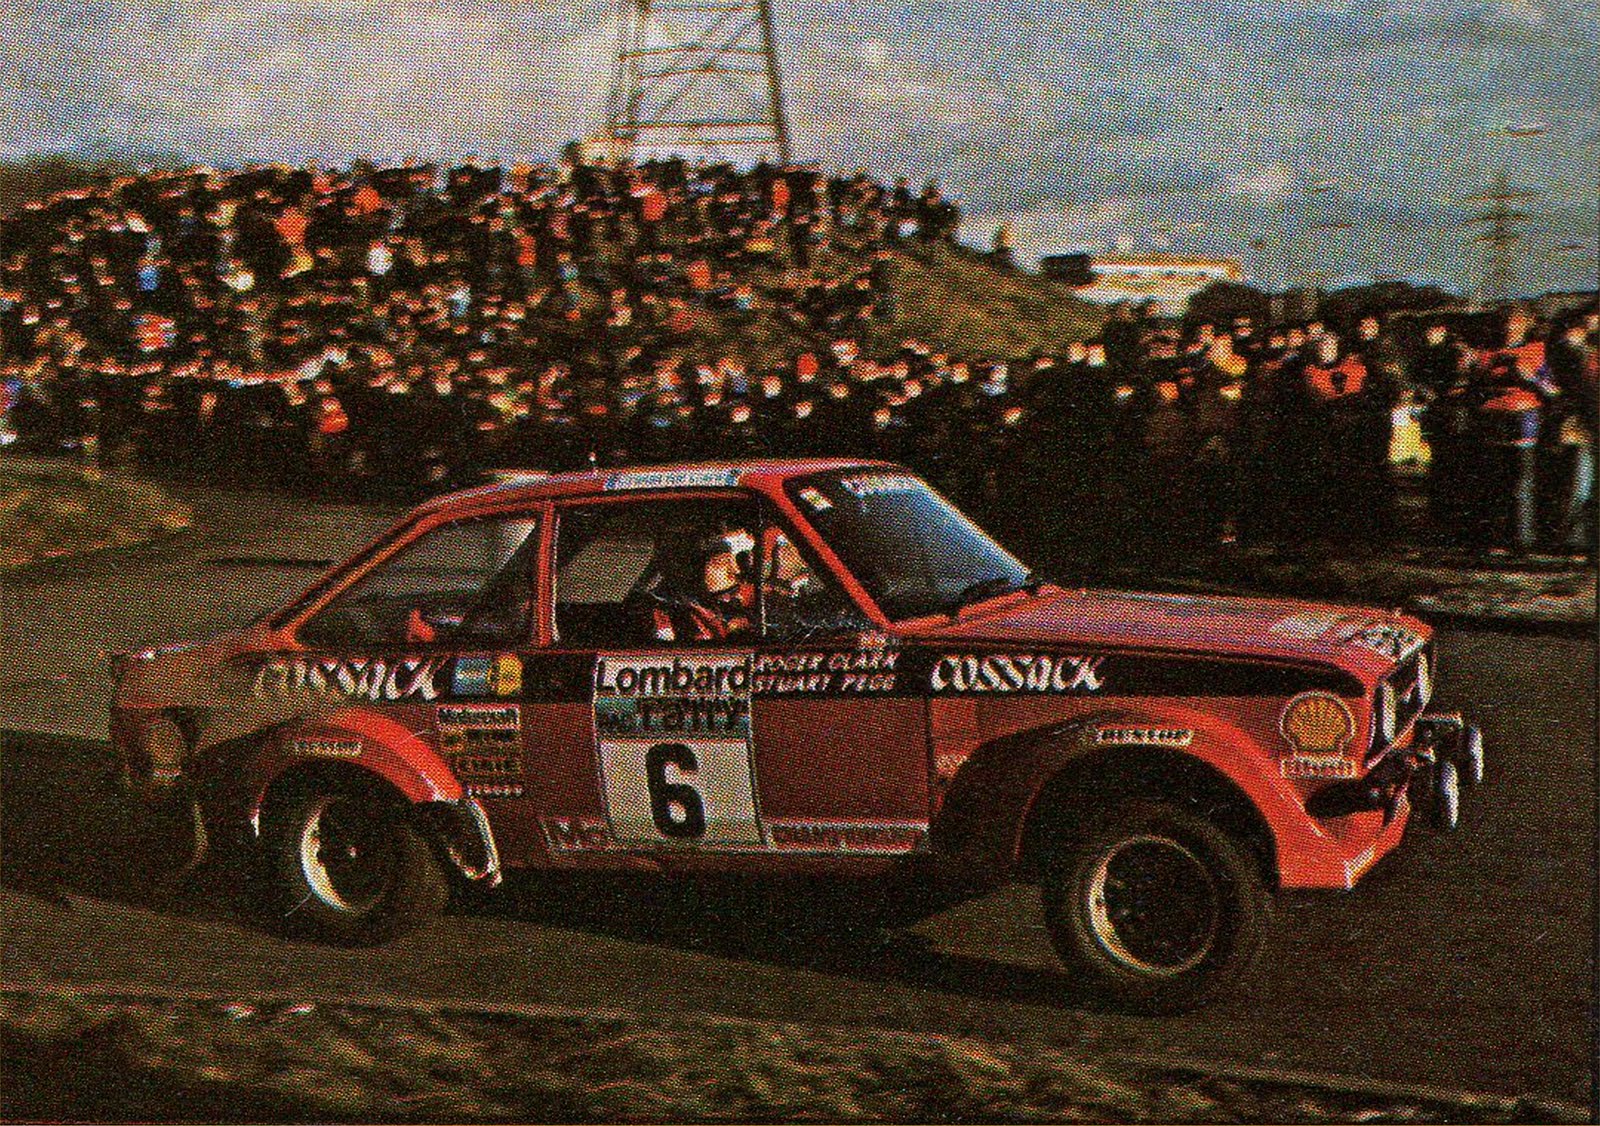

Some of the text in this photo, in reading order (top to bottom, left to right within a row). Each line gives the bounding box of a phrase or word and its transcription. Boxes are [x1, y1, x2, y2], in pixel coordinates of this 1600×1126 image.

[596, 656, 751, 694] Lombard
[828, 650, 901, 672] CLARK
[930, 654, 1105, 693] COSSACK
[645, 742, 708, 839] 6
